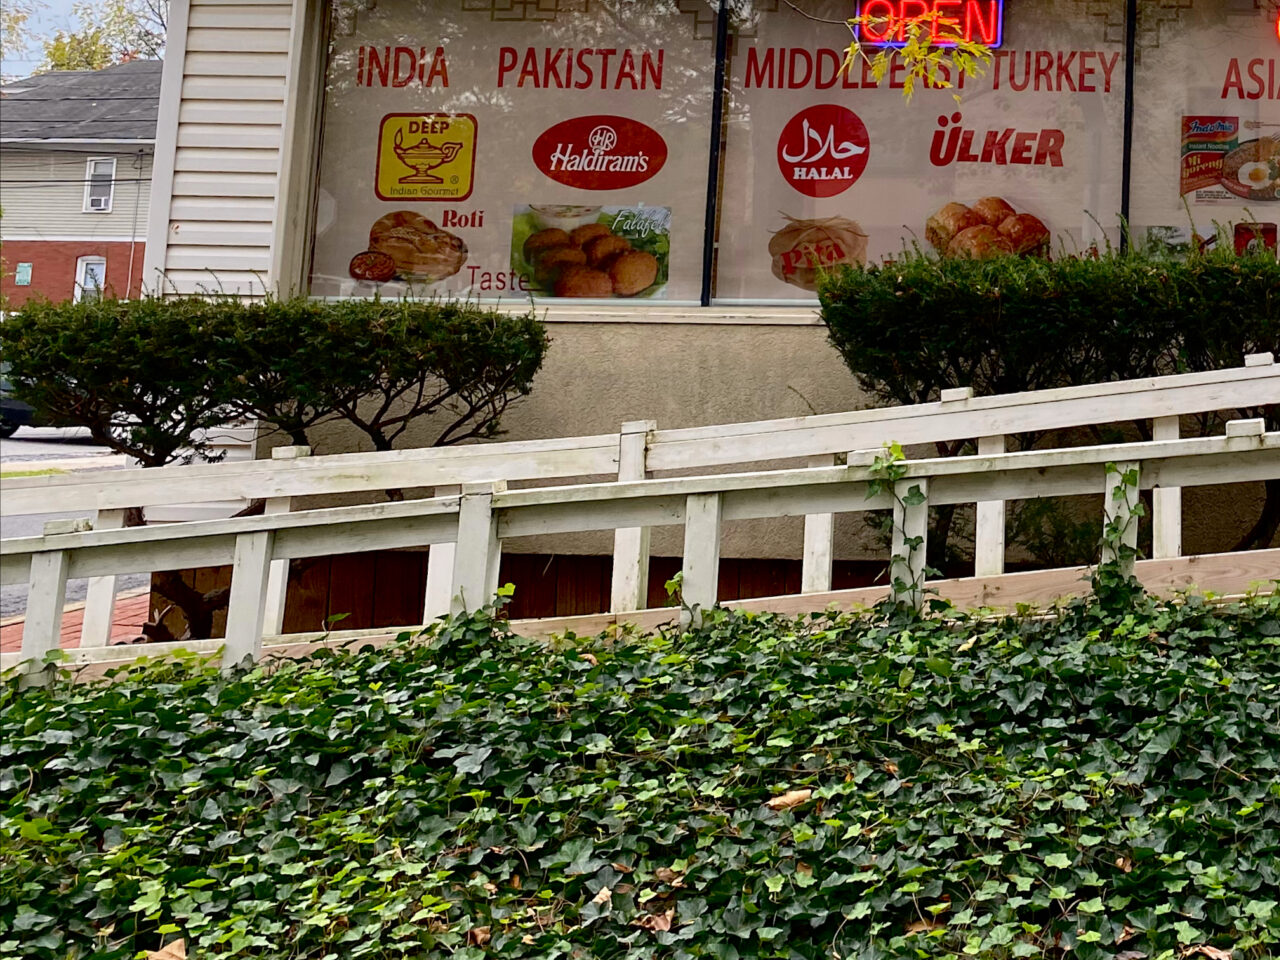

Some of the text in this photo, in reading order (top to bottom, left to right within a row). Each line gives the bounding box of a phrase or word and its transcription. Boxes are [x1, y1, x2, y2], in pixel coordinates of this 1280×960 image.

[357, 45, 664, 90] INDIA PAKISTAN
[993, 50, 1120, 93] TURKEY
[408, 120, 450, 136] DEEP
[782, 118, 866, 164] حلال
[929, 111, 1065, 167] ÜLKER
[549, 143, 650, 172] Haldiram's
[793, 166, 853, 180] HALAL
[390, 185, 459, 197] Indian Gourmet
[442, 210, 484, 228] Roti
[781, 242, 846, 275] Pita
[467, 266, 531, 291] Taste
